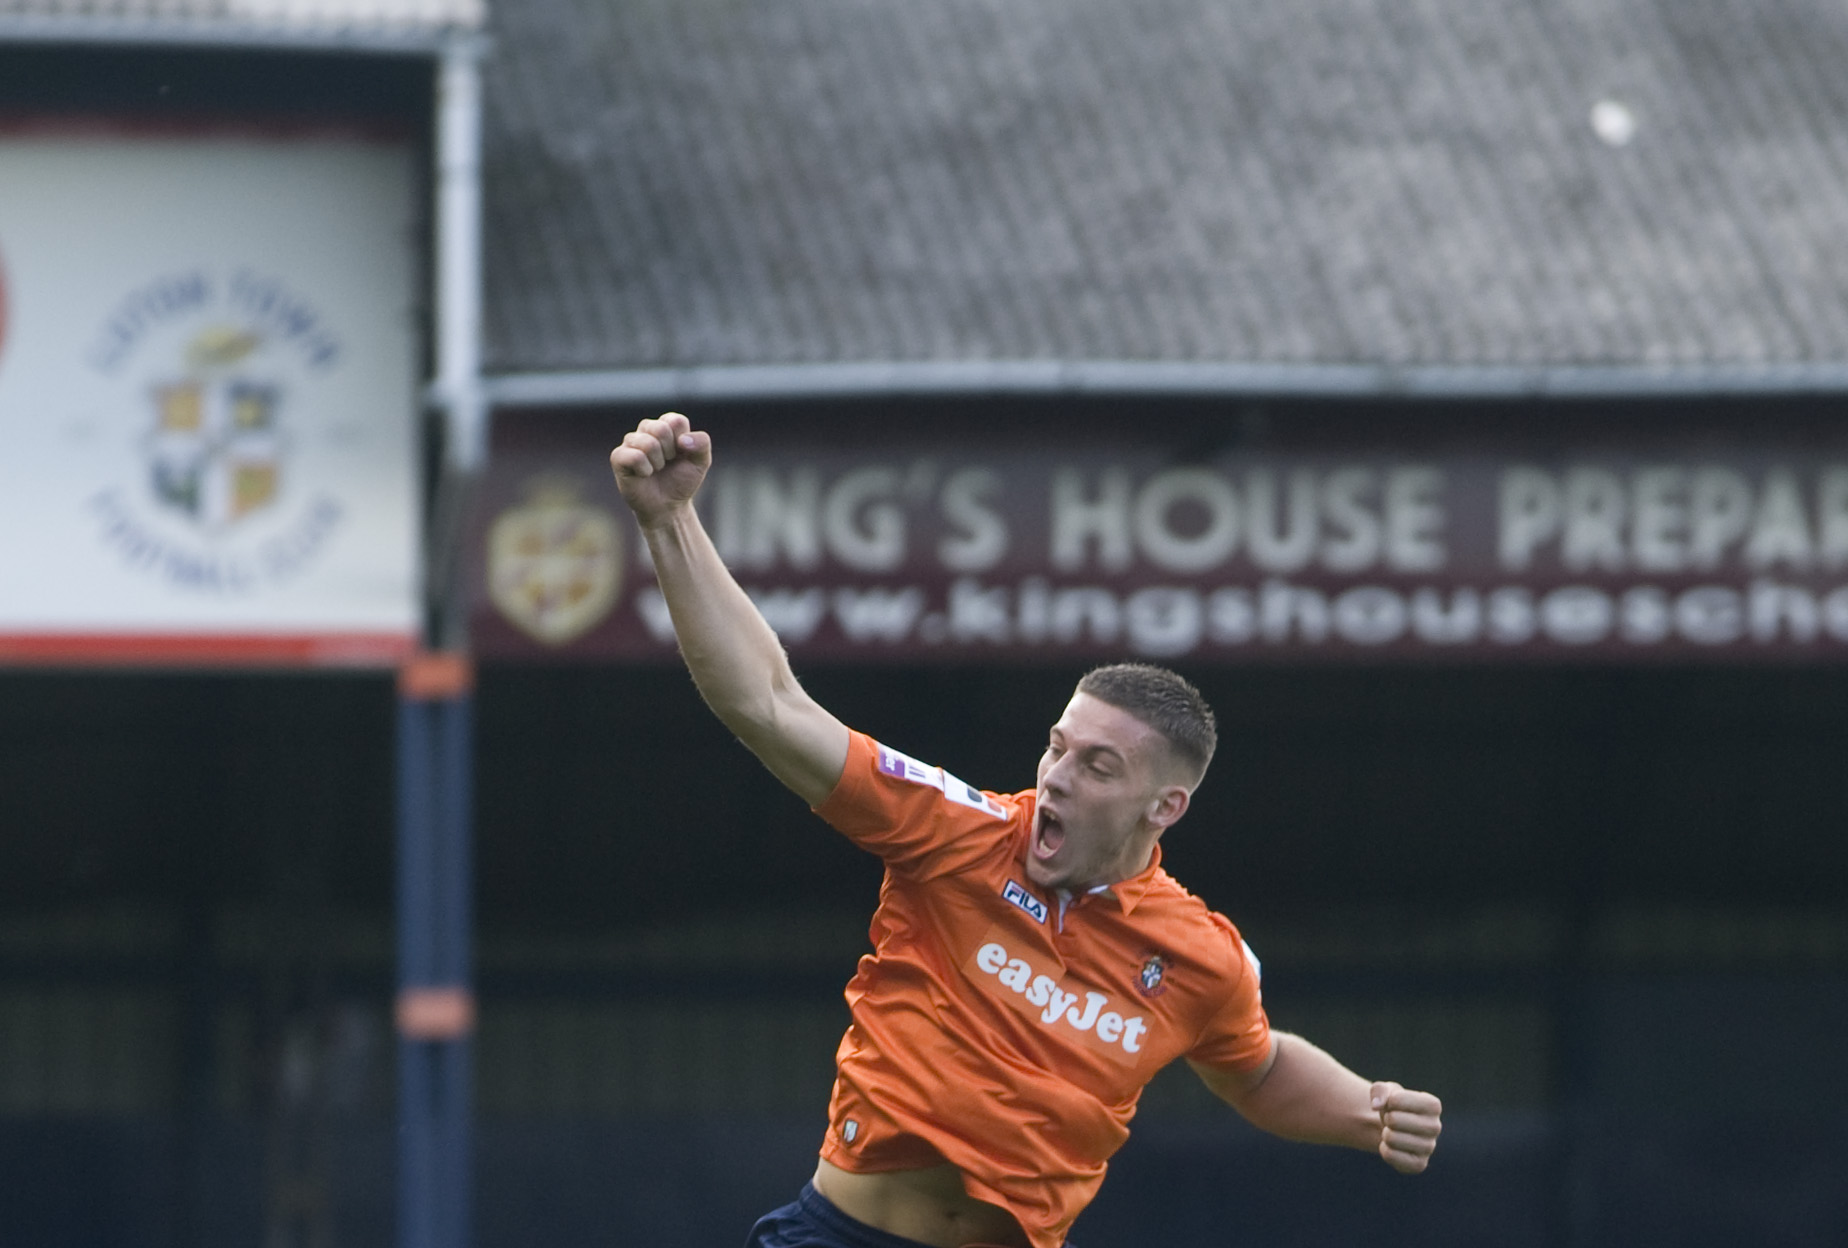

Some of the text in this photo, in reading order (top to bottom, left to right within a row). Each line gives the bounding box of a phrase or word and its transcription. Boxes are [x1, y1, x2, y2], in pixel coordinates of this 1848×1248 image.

[638, 463, 1008, 572] ING'S
[1051, 463, 1446, 573] HOUSE
[1007, 885, 1042, 918] FILA
[976, 943, 1147, 1053] easyJet
